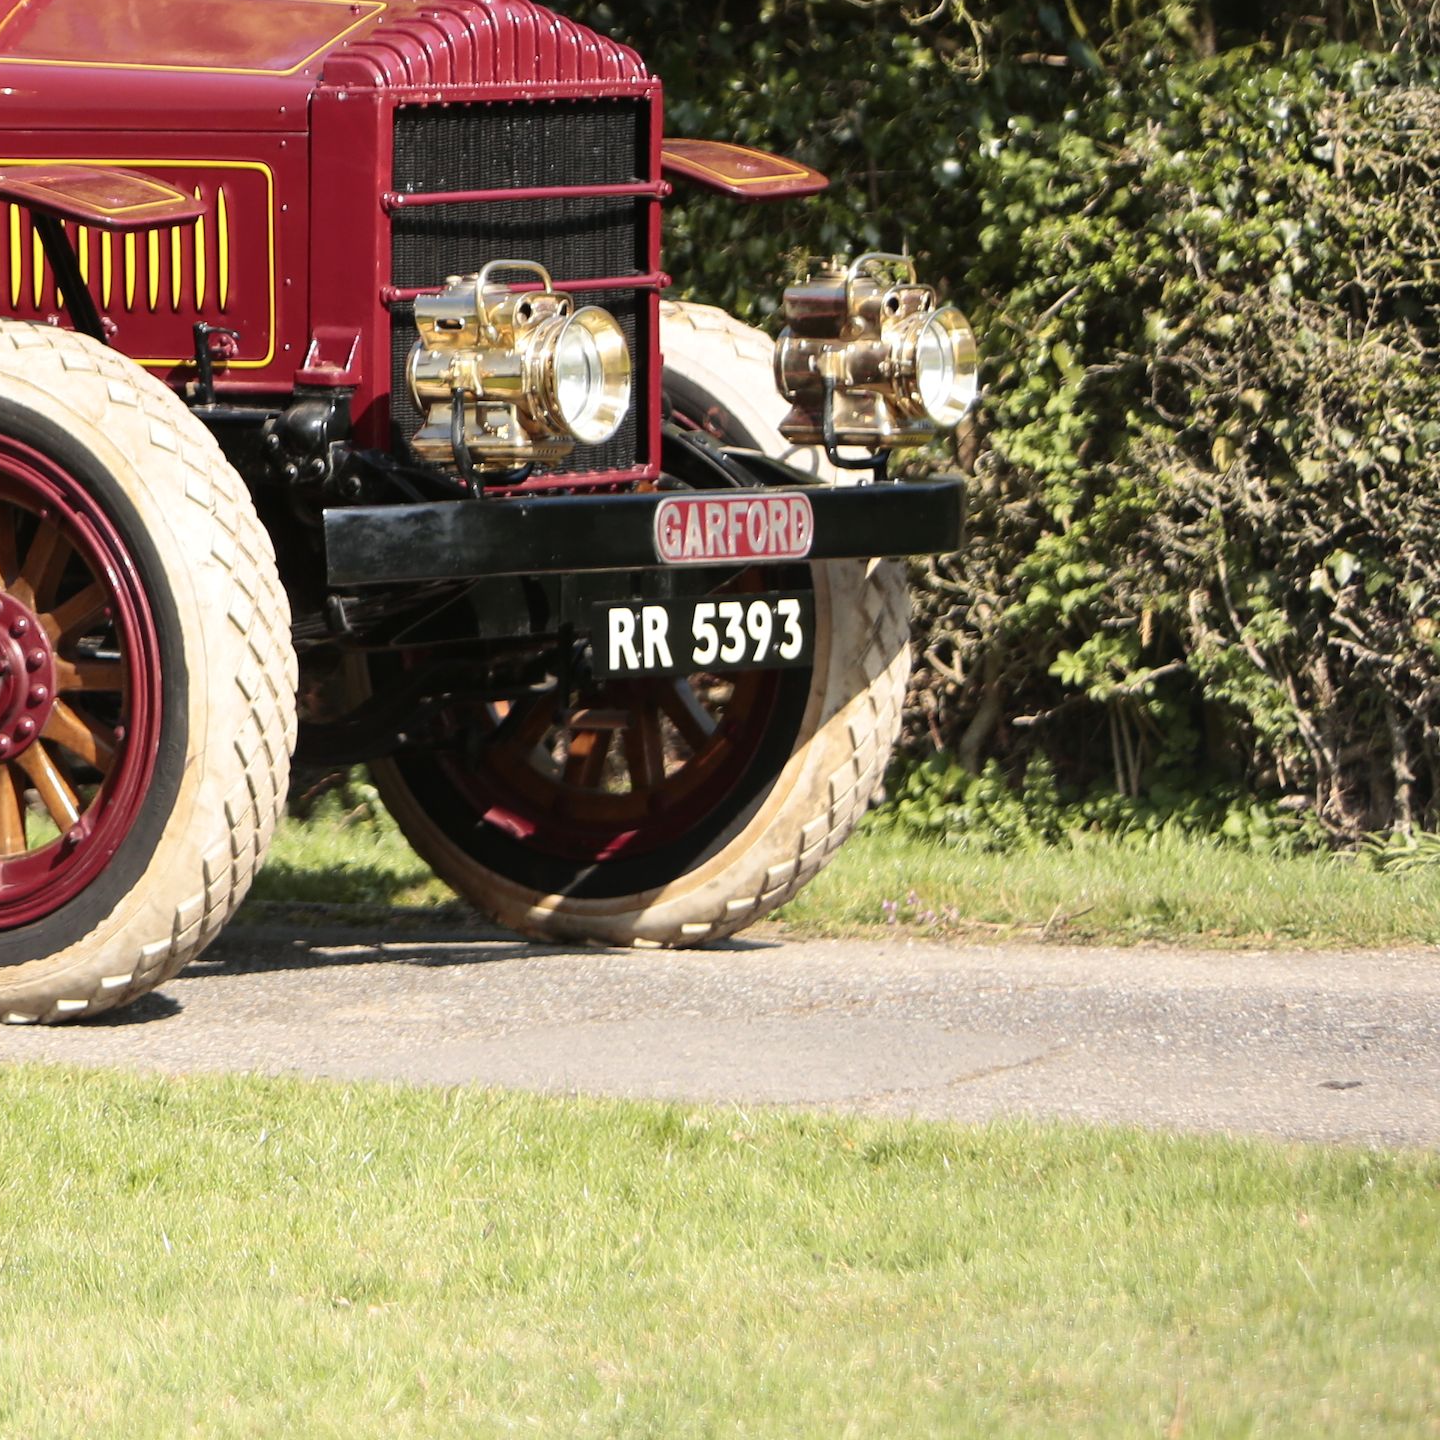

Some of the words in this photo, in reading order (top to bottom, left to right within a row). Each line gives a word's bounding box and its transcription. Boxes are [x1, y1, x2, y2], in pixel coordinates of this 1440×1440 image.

[661, 499, 810, 557] GARFORD
[607, 605, 673, 672] RR
[691, 597, 804, 666] 5393
